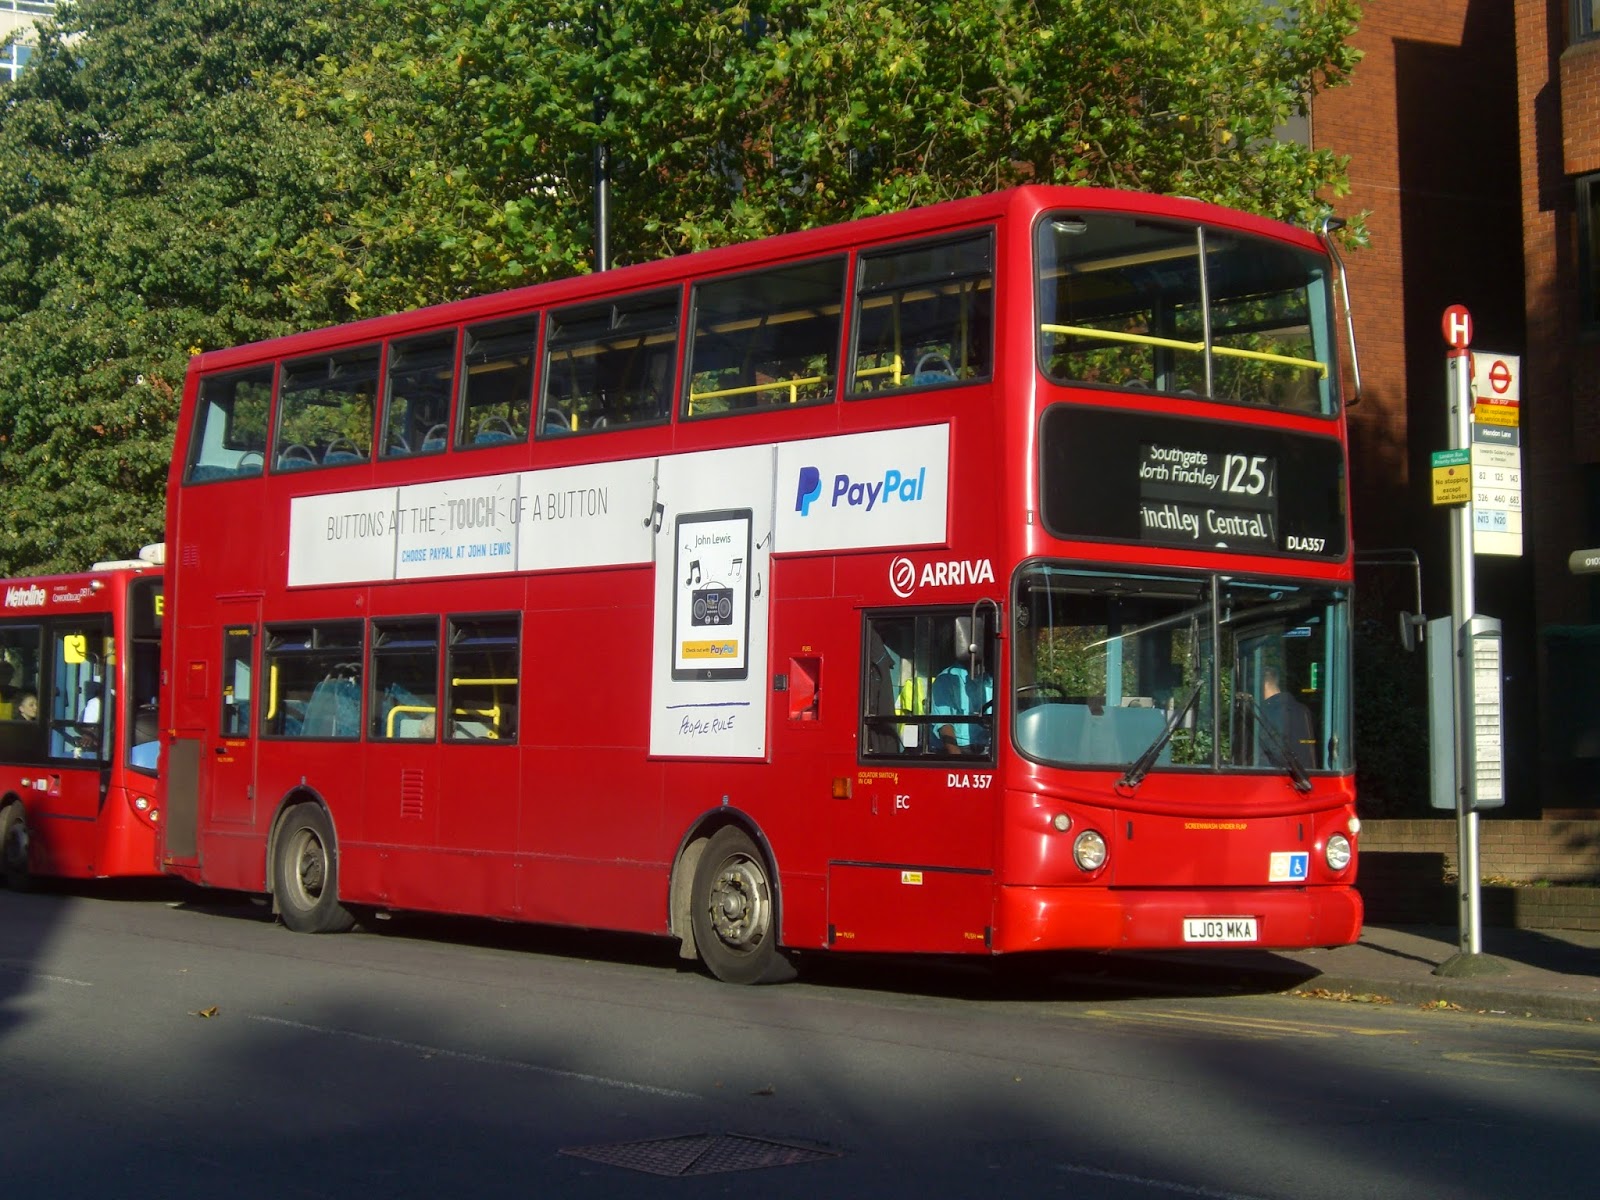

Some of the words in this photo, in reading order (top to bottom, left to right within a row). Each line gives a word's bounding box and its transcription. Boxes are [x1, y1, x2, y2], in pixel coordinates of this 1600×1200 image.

[1451, 312, 1468, 345] H
[1150, 445, 1208, 468] Southgate
[1172, 464, 1220, 490] Finchley
[1221, 454, 1267, 495] 125
[1479, 471, 1486, 480] 82
[1494, 473, 1504, 481] 125
[1509, 474, 1518, 483] 143
[831, 467, 927, 512] PayPal
[1478, 493, 1488, 502] 326
[1494, 494, 1505, 503] 460
[327, 511, 385, 540] BUTTONS
[411, 506, 436, 533] THE
[448, 495, 496, 531] TOUCH
[509, 496, 528, 525] OF
[532, 495, 542, 521] A
[547, 487, 609, 520] BUTTON
[1140, 504, 1199, 539] inchley
[1206, 509, 1267, 537] Central
[1477, 515, 1489, 524] N13
[1494, 516, 1506, 525] N20
[695, 535, 711, 548] John
[712, 533, 731, 544] Lewis
[1286, 536, 1325, 552] DLA357
[402, 549, 427, 562] CHOOSE
[429, 547, 453, 560] PAYPAL
[456, 545, 465, 558] AT
[468, 544, 486, 558] JOHN
[489, 542, 511, 556] LEWIS
[1585, 556, 1600, 567] 010
[919, 559, 995, 587] ARRIVA
[5, 584, 46, 607] Metroline
[710, 644, 735, 655] PayPal
[679, 715, 709, 737] PEOPLE
[711, 715, 735, 734] RULE
[947, 774, 970, 788] DLA
[972, 775, 992, 789] 357
[896, 795, 910, 809] EC
[964, 932, 976, 940] PUSH
[1189, 922, 1223, 938] LJ03
[1227, 922, 1252, 938] MKA
